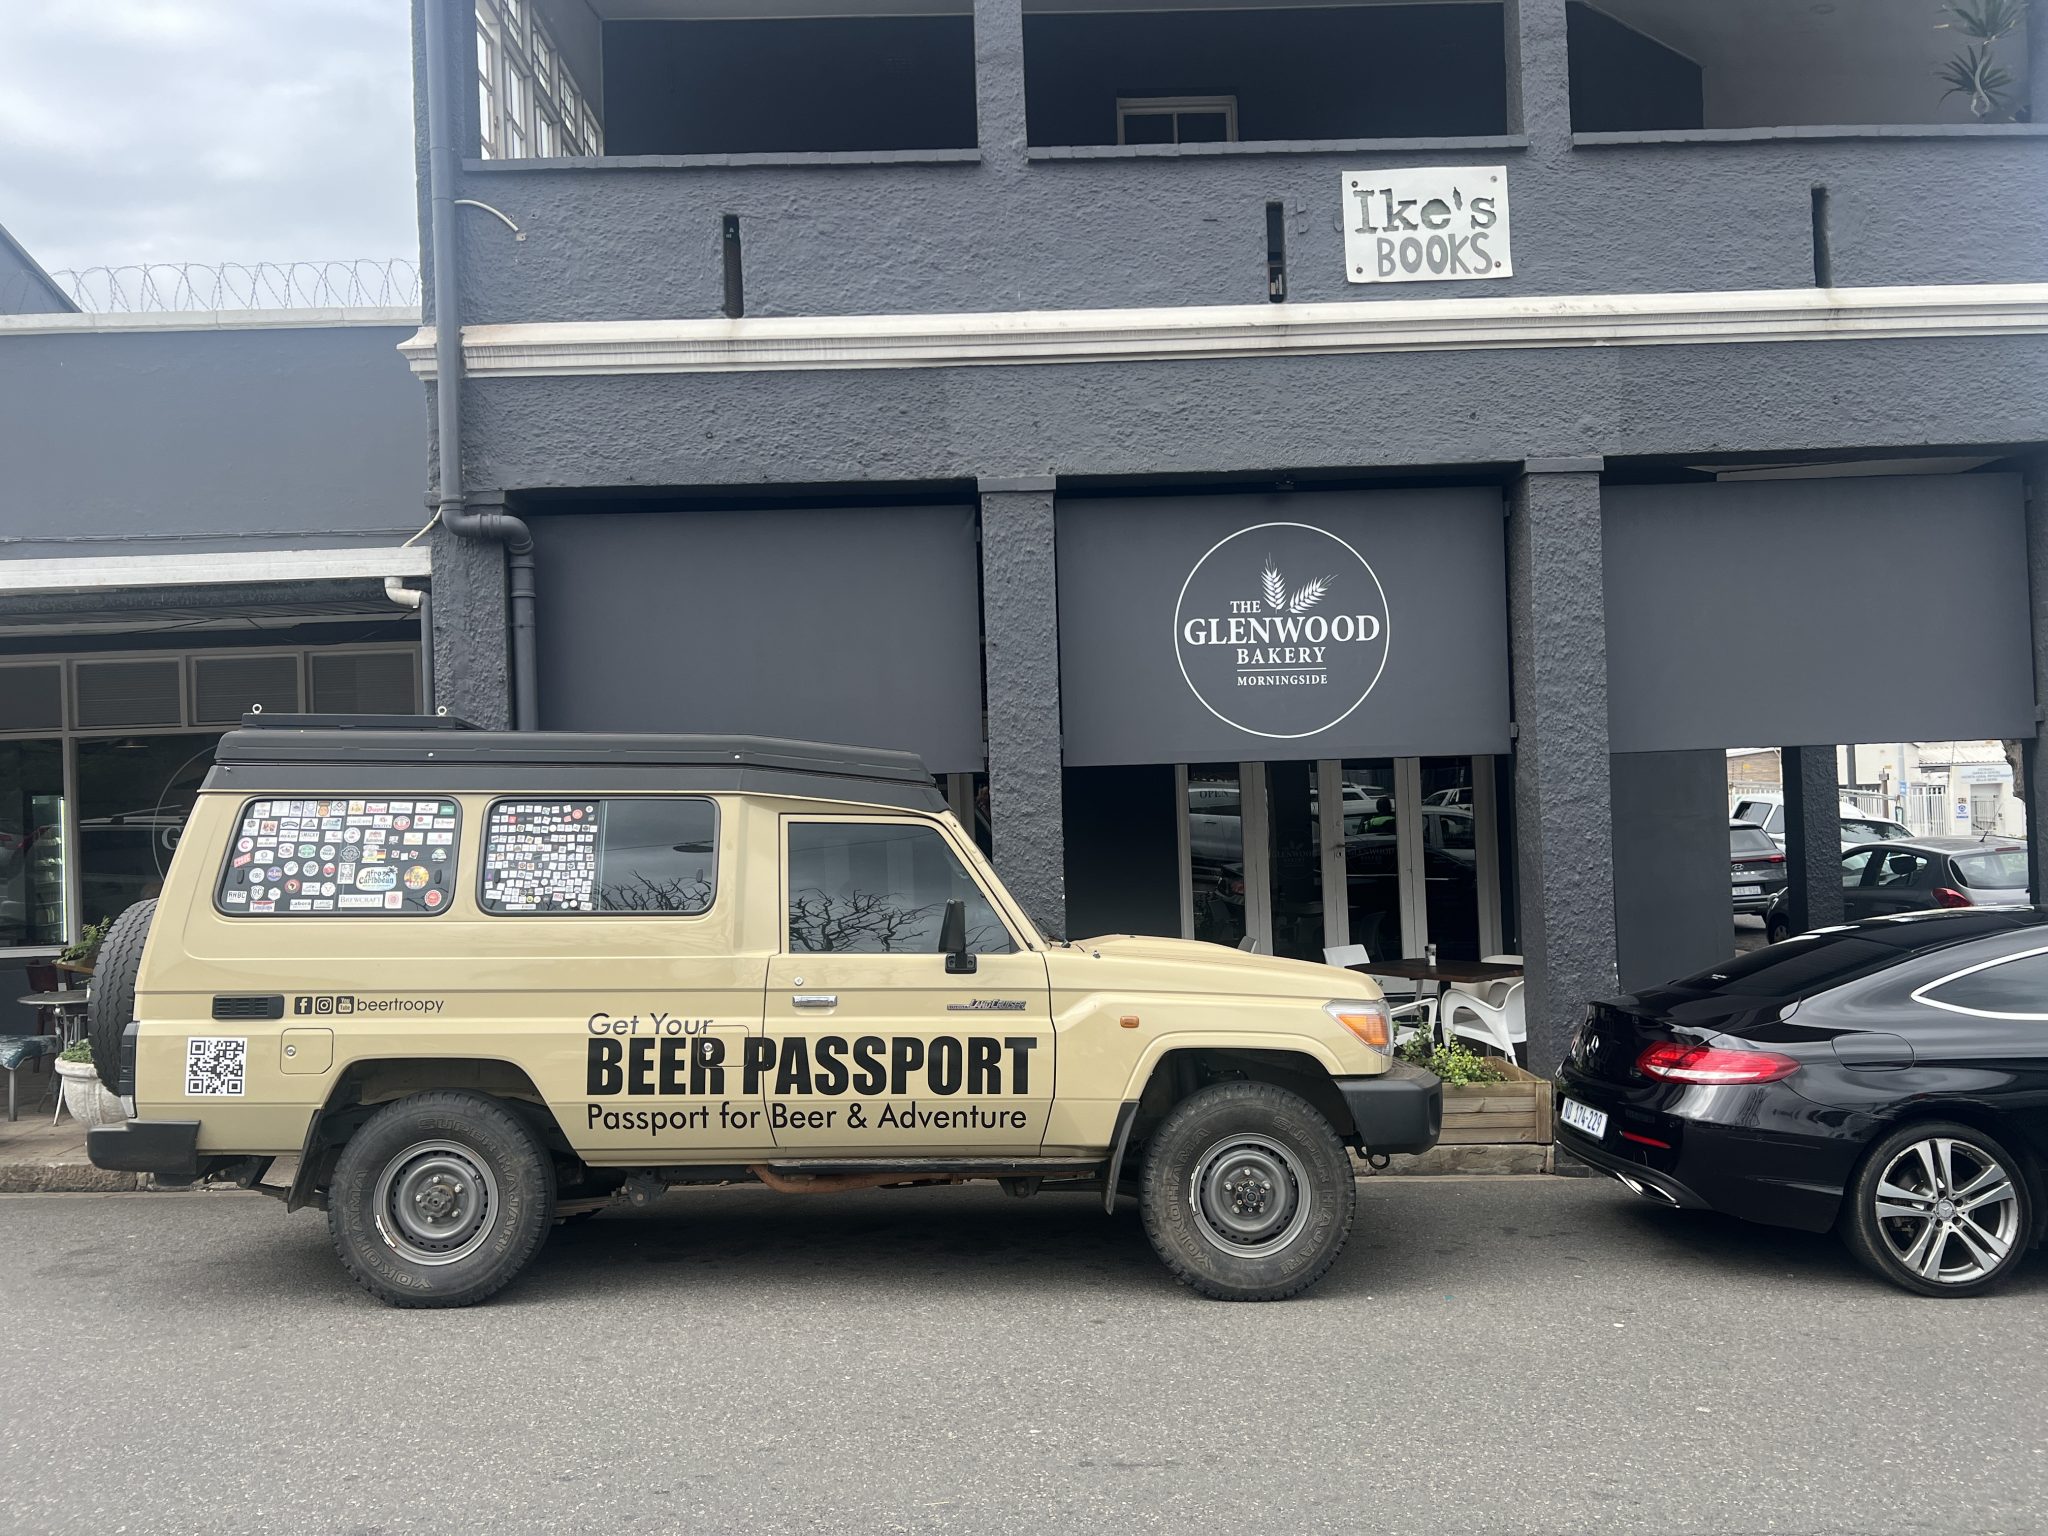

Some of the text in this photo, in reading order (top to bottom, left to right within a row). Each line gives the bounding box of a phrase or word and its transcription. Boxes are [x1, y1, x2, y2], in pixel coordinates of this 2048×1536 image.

[1353, 186, 1497, 234] Ike's
[1376, 231, 1493, 277] BOOKS
[1229, 600, 1262, 614] THE
[1183, 614, 1380, 646] GLENWOOD
[1236, 646, 1327, 665] BAKERY
[1236, 674, 1328, 686] MORNINGSIDE
[1200, 790, 1230, 799] OPEN
[358, 876, 394, 885] Caribbean
[357, 998, 444, 1013] beertroopy
[587, 1012, 714, 1035] Get Your
[586, 1035, 1037, 1096] BEER PASSPORT
[587, 1101, 1027, 1136] Passport for Beer & Adventure
[418, 1117, 498, 1153] SUPER
[1167, 1127, 1213, 1272] YOKOHAMA
[350, 1169, 432, 1289] YOKOHAMA
